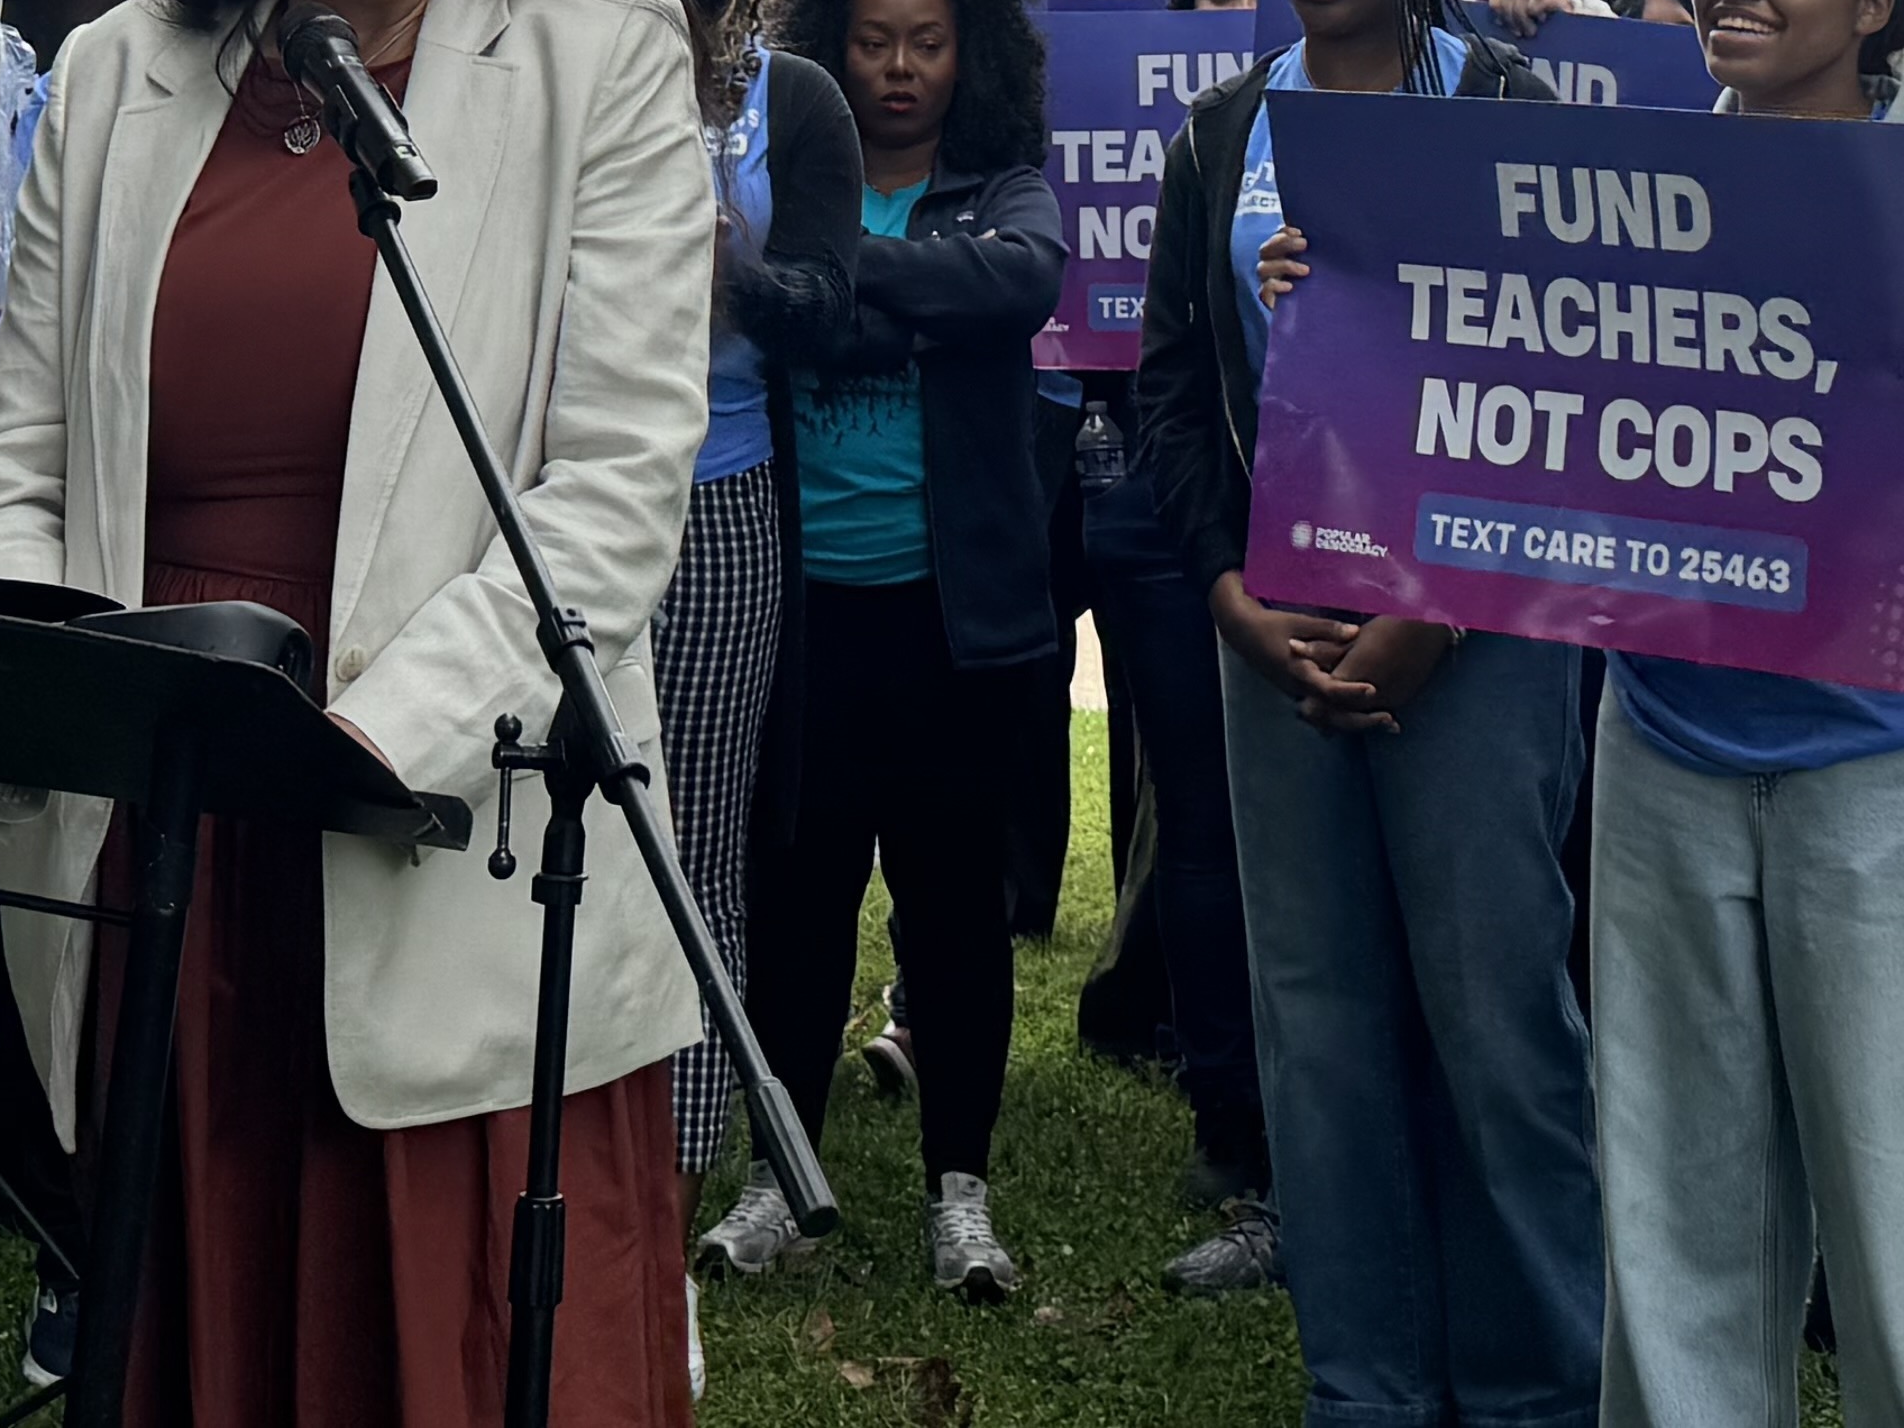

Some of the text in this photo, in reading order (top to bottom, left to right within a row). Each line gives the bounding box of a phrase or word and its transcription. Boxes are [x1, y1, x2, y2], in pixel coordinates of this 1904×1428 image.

[1495, 162, 1712, 252] FUND
[1397, 263, 1839, 394] TEACHERS,
[1415, 377, 1823, 502] NOT COPS
[1430, 513, 1790, 594] TEXT CARE TO 25463
